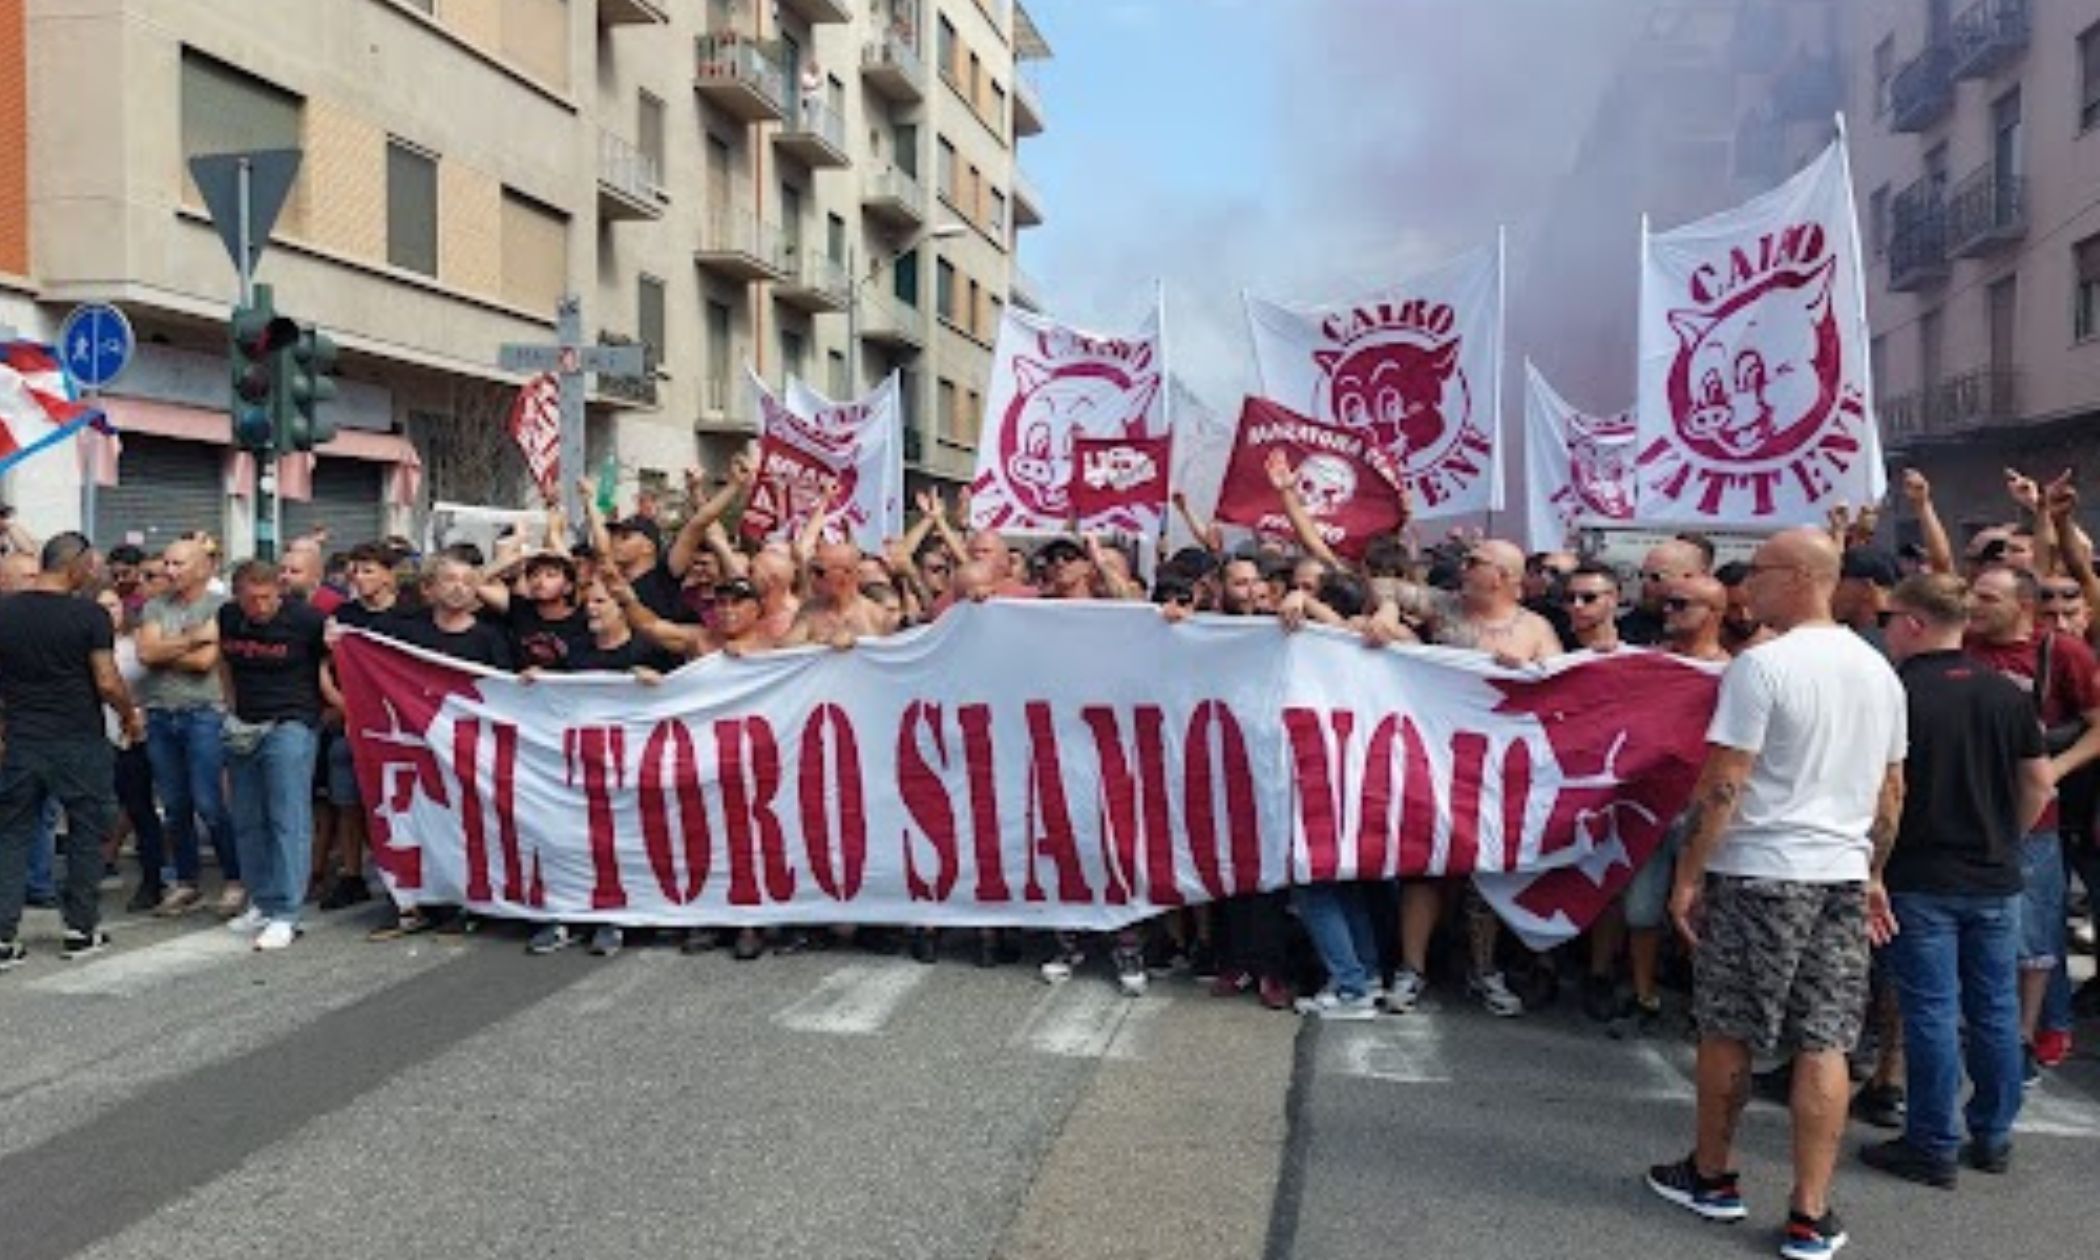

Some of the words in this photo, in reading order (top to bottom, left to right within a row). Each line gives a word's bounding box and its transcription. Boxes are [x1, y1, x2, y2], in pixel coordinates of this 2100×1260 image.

[1322, 298, 1455, 342] CAIRO
[452, 716, 546, 908] IL
[562, 702, 868, 910] TORO
[896, 698, 1262, 906] SIAMO
